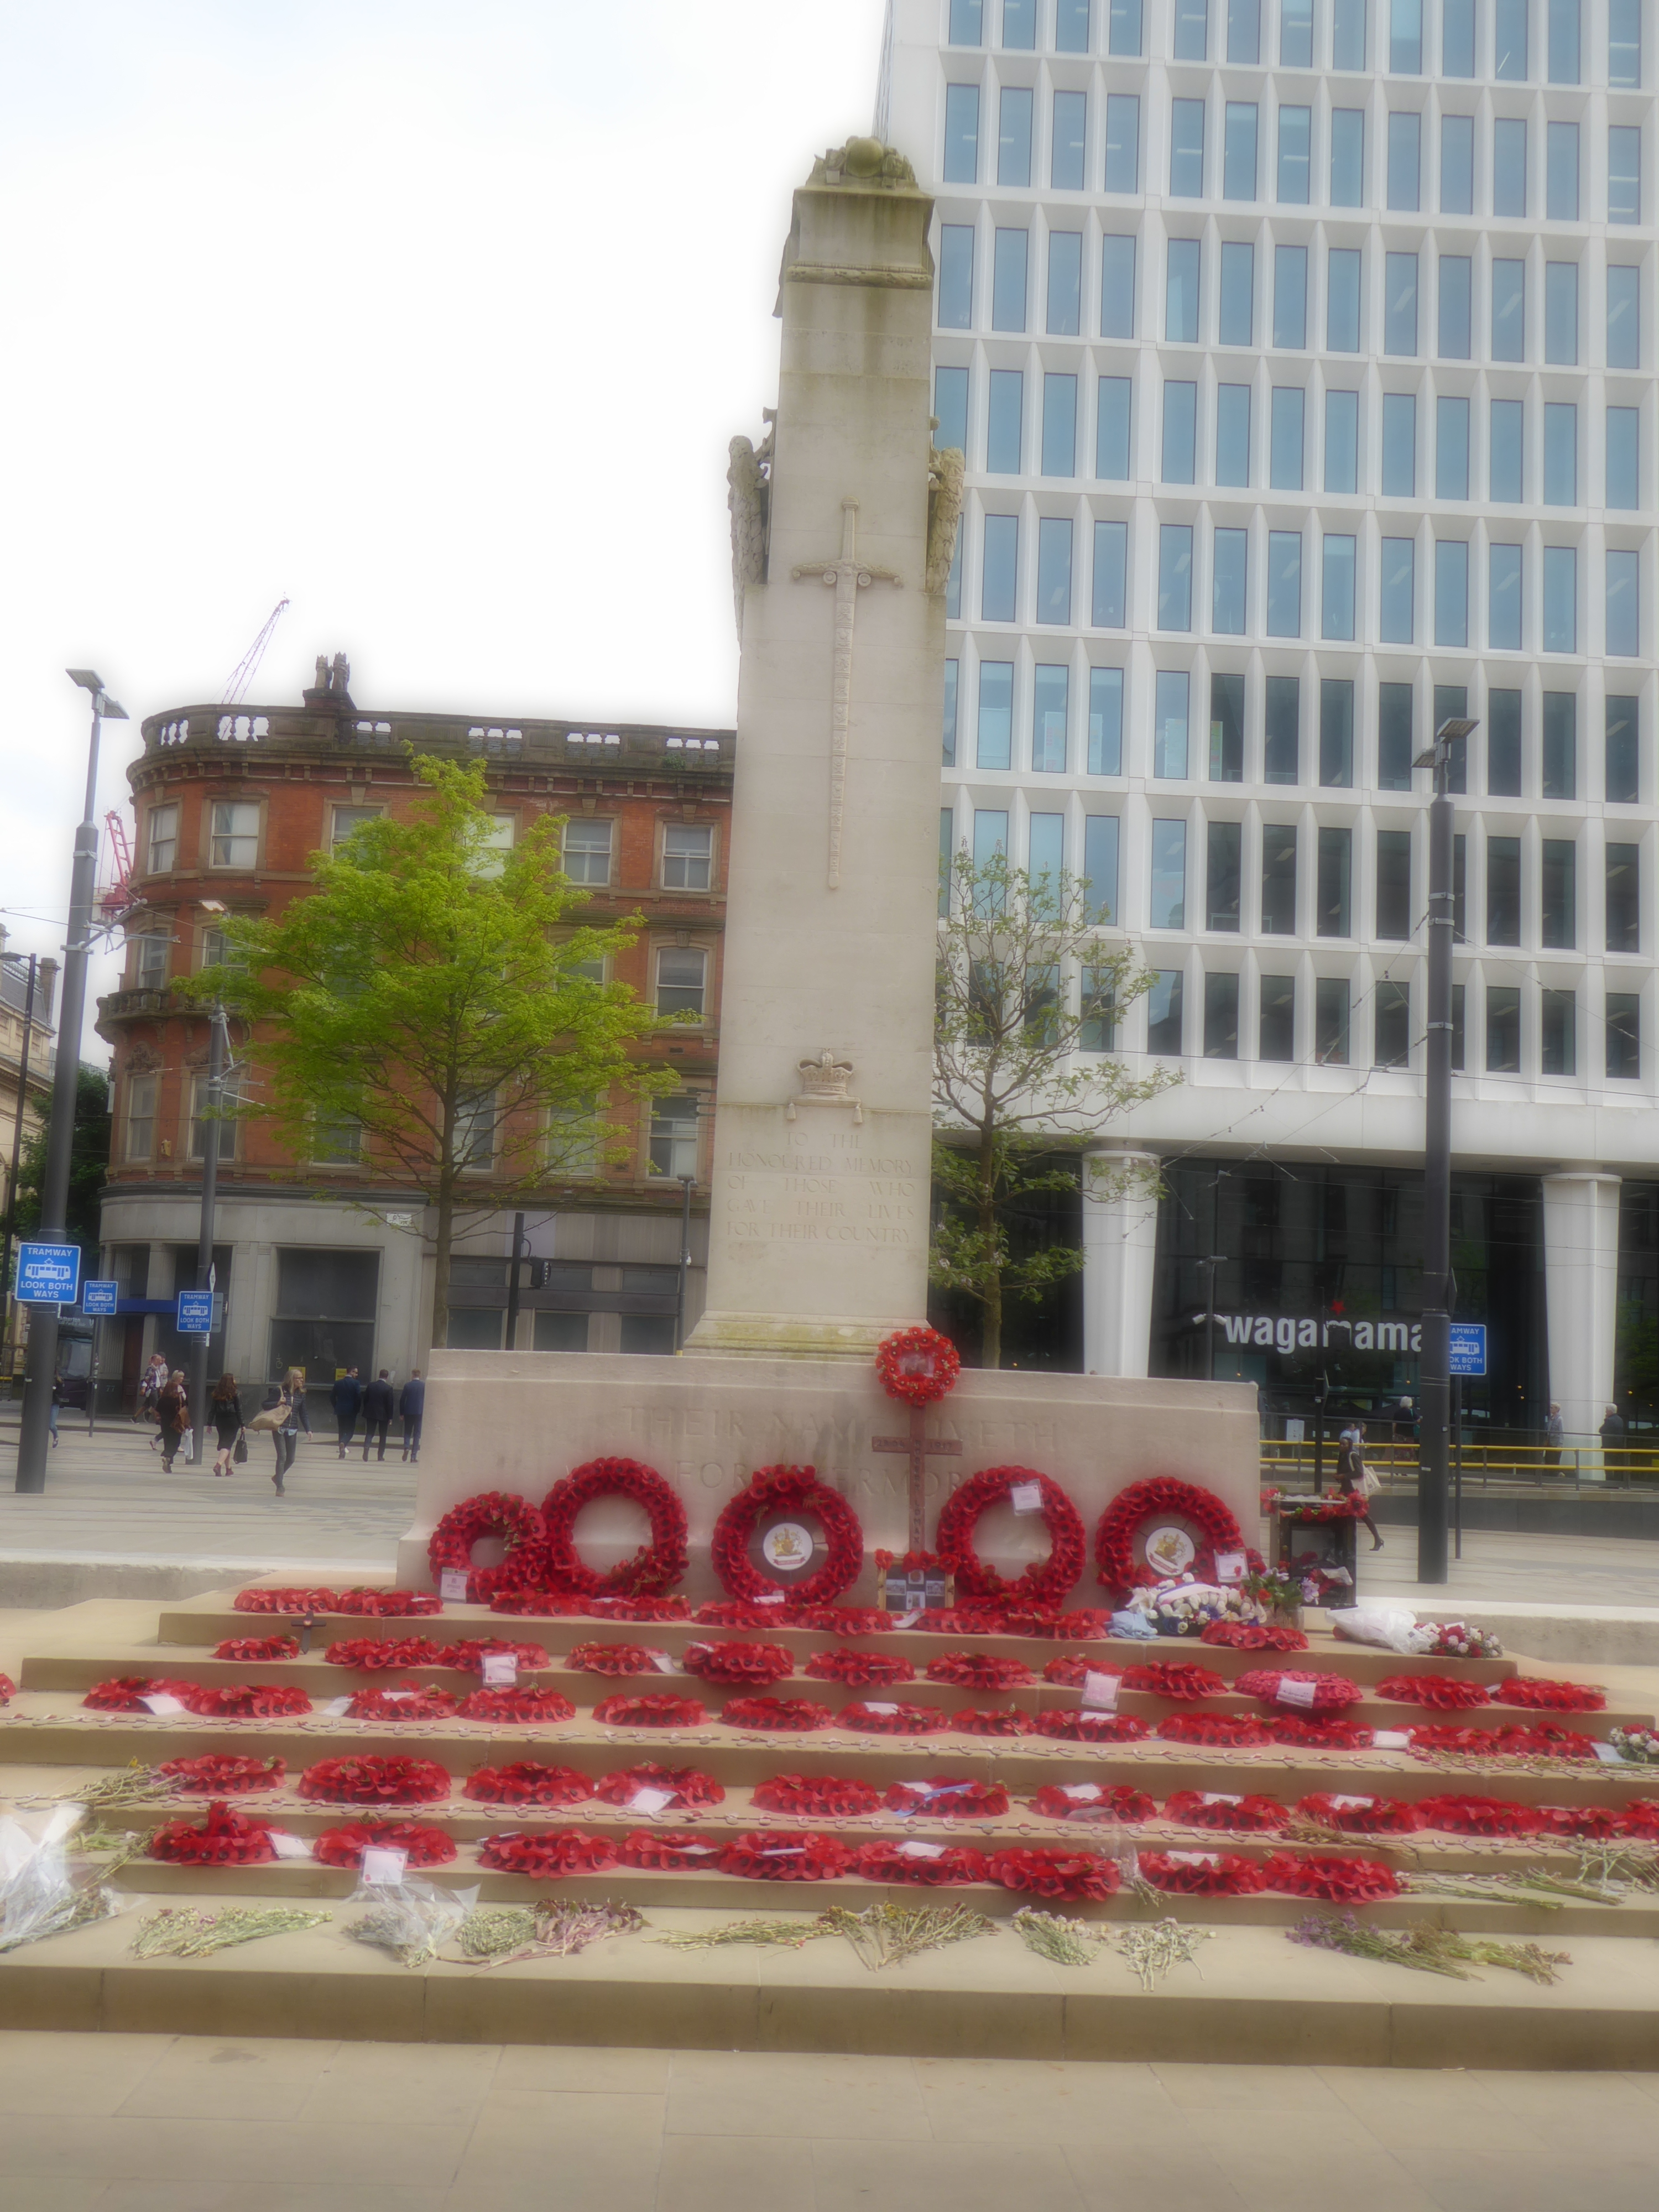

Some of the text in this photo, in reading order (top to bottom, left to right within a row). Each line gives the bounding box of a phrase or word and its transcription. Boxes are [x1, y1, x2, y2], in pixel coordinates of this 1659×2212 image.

[784, 1131, 863, 1149] TO THE
[728, 1152, 913, 1175] HONOURED MEMORY
[727, 1176, 915, 1197] OF THOSE WHO
[727, 1198, 915, 1220] GAVE THEIR LIVES
[727, 1221, 760, 1237] FOR
[769, 1223, 819, 1240] THEIR
[27, 1247, 72, 1257] TRAMWAY
[21, 1281, 73, 1290] LOOK BOTH
[34, 1290, 59, 1298] WAYS
[935, 1418, 1058, 1451] IVETH
